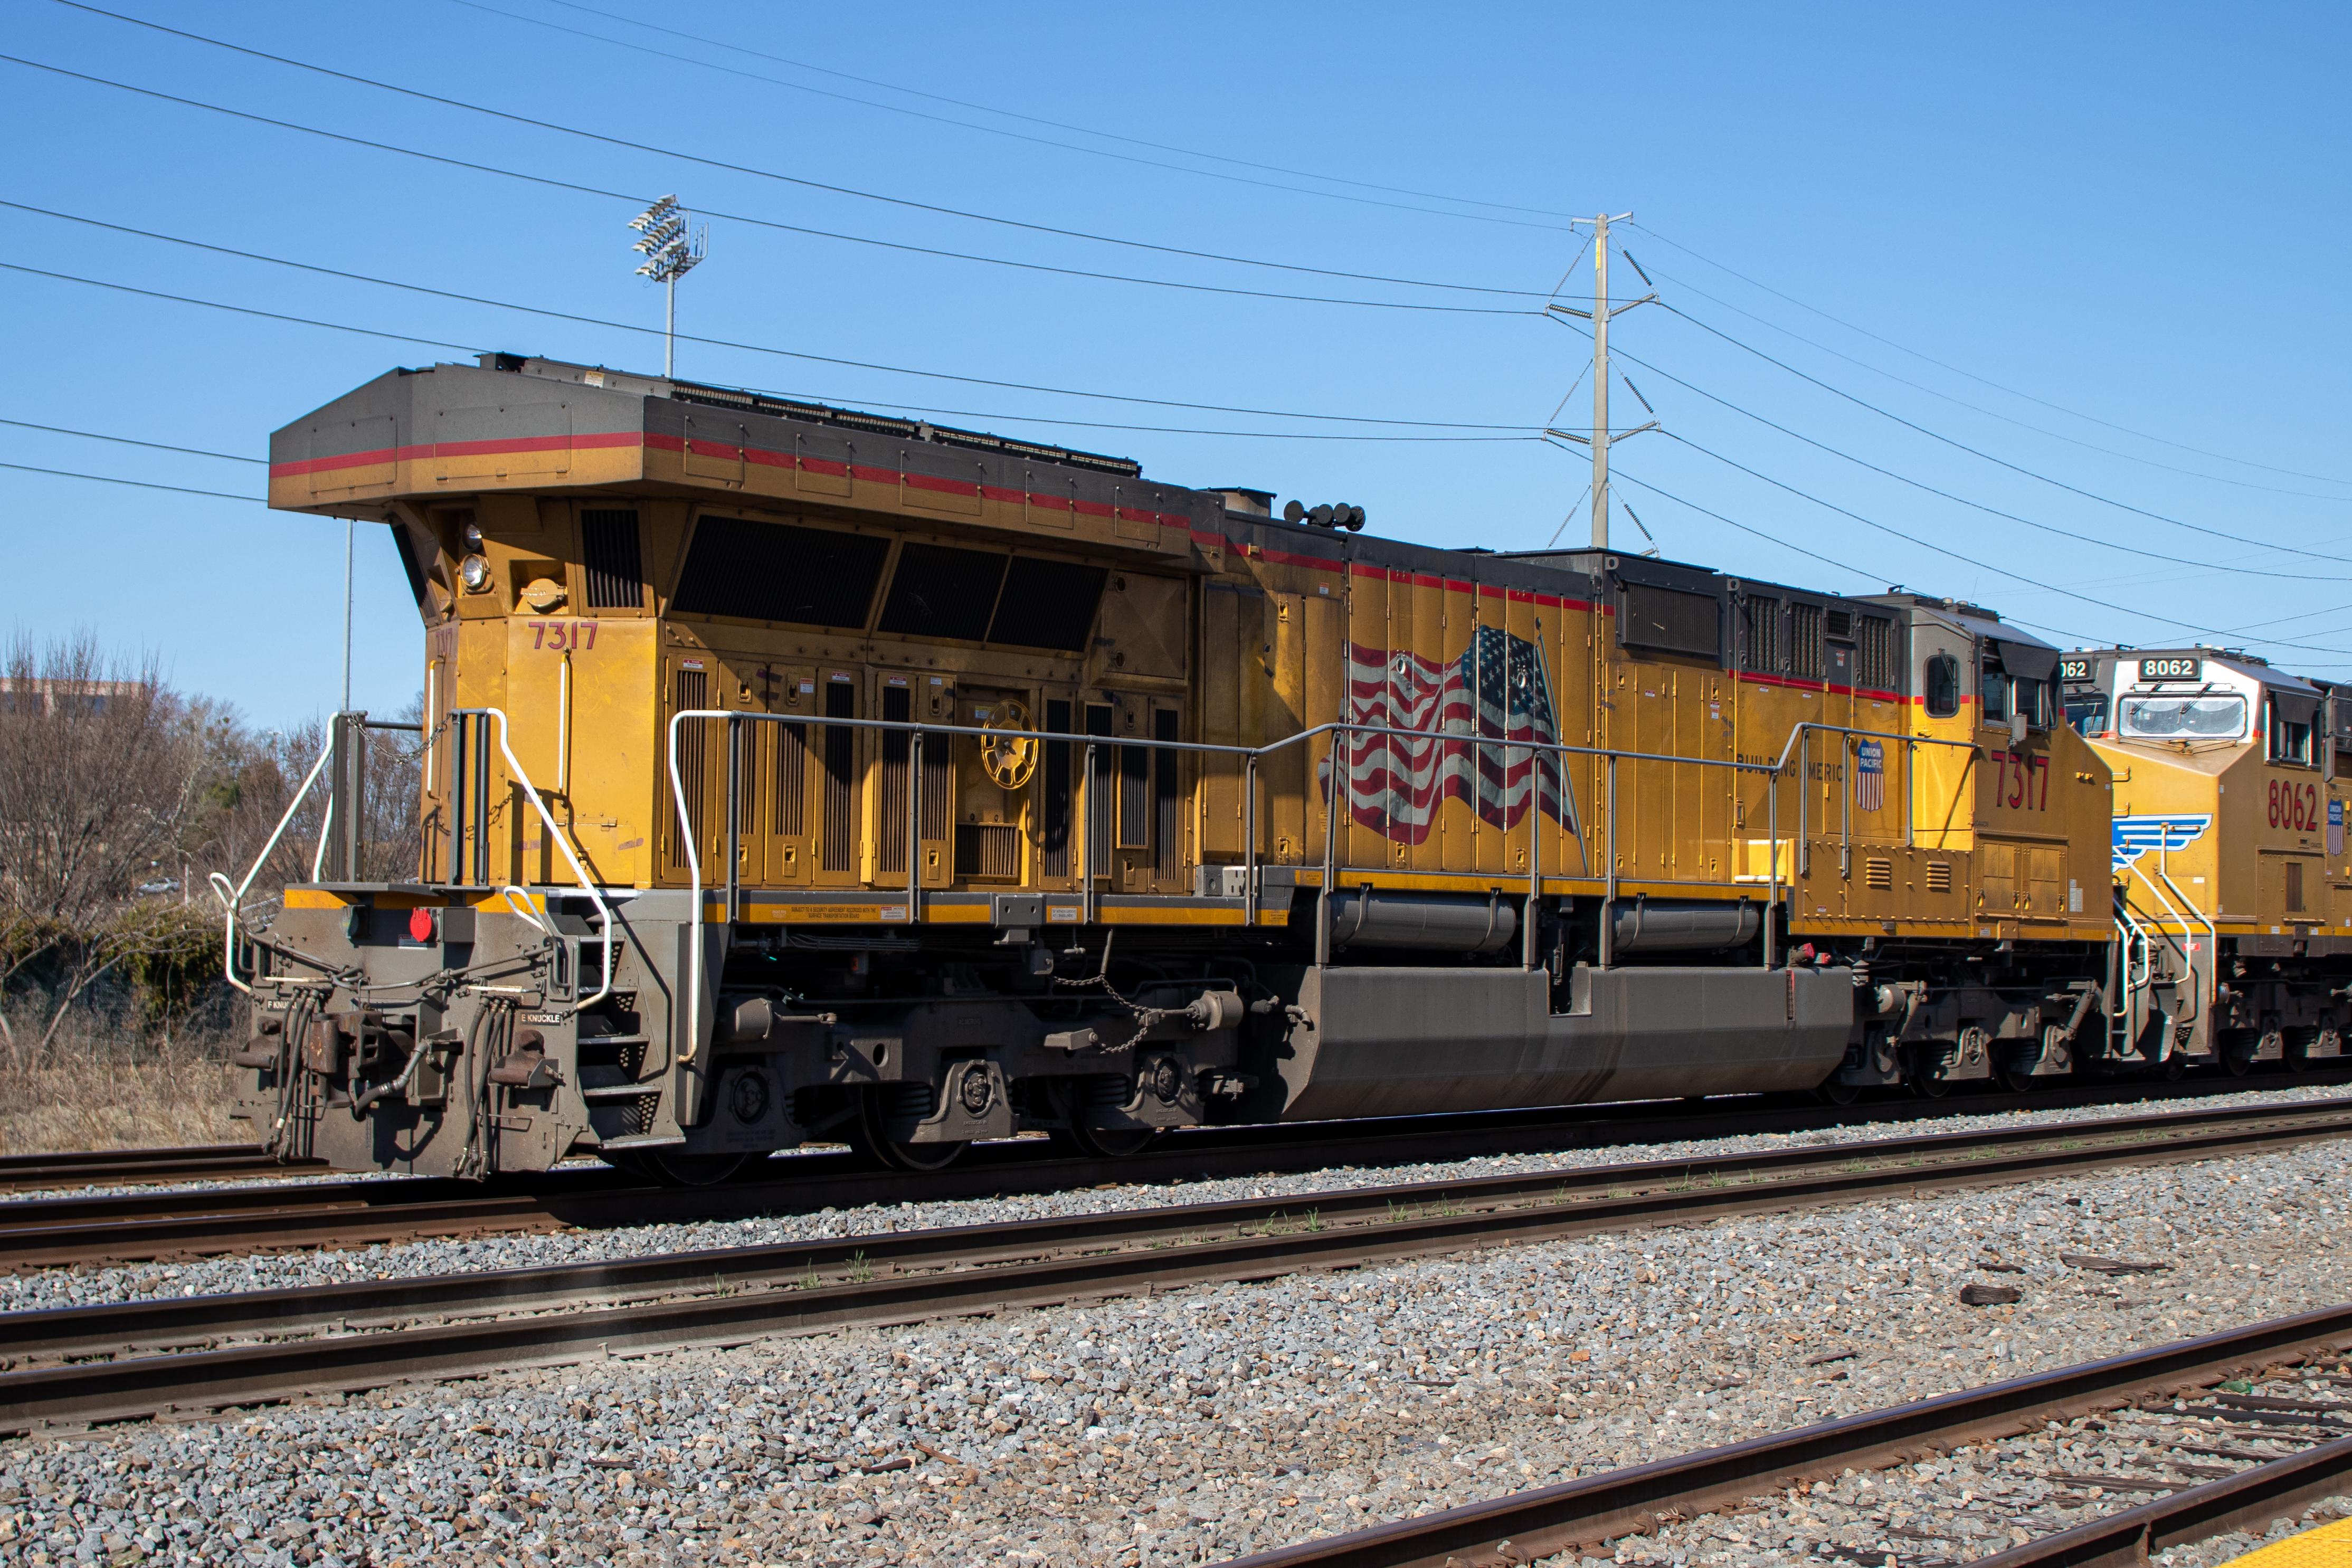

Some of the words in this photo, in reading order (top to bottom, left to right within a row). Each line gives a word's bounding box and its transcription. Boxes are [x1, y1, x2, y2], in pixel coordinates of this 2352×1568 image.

[528, 621, 598, 650] 7317
[2145, 660, 2194, 676] 8062
[1860, 757, 1882, 768] PACIFIC
[1861, 747, 1881, 757] UNION
[1737, 753, 1796, 777] BUILDNG
[1800, 761, 1850, 783] MERIC
[1991, 749, 2050, 811] 7317
[2269, 779, 2318, 832] 8062
[527, 1014, 560, 1023] KNUCKLE
